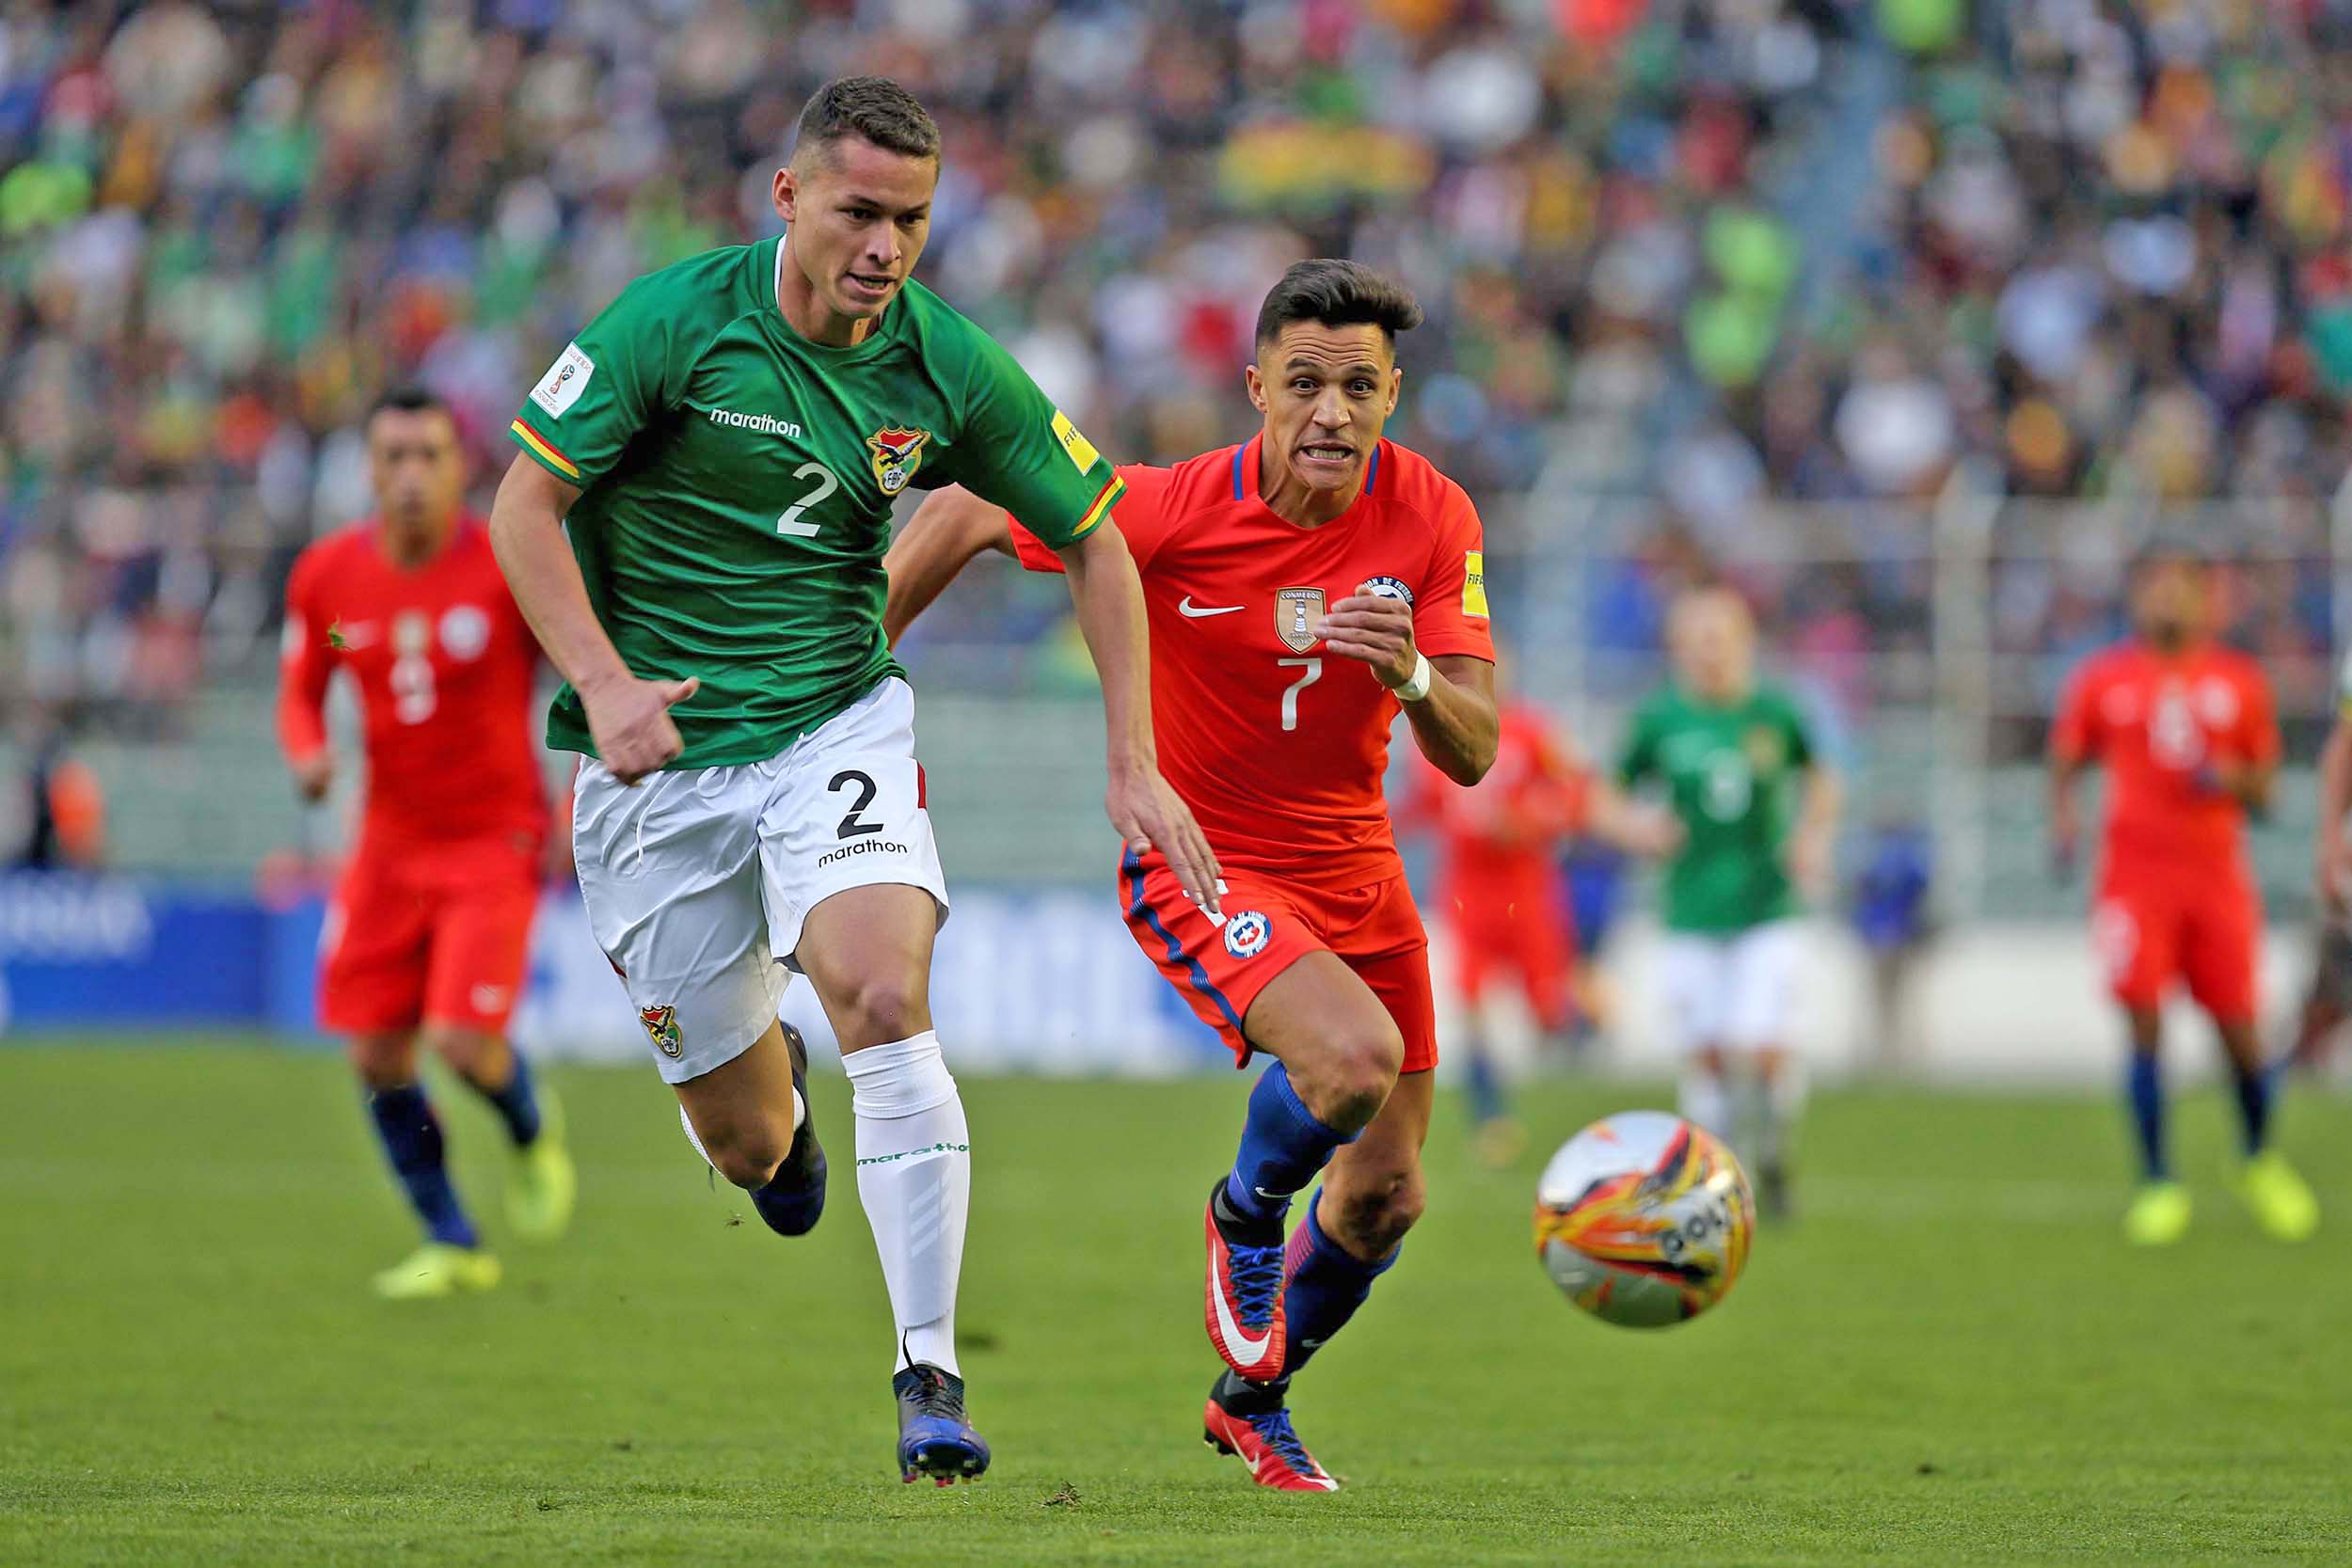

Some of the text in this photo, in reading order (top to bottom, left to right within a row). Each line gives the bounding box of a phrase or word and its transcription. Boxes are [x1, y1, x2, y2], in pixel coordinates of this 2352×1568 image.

[709, 408, 801, 438] marathon
[776, 462, 838, 538] 2
[1280, 592, 1322, 600] CONMEBOL
[1278, 657, 1322, 731] 7
[827, 769, 884, 840] 2
[818, 839, 908, 868] marathon
